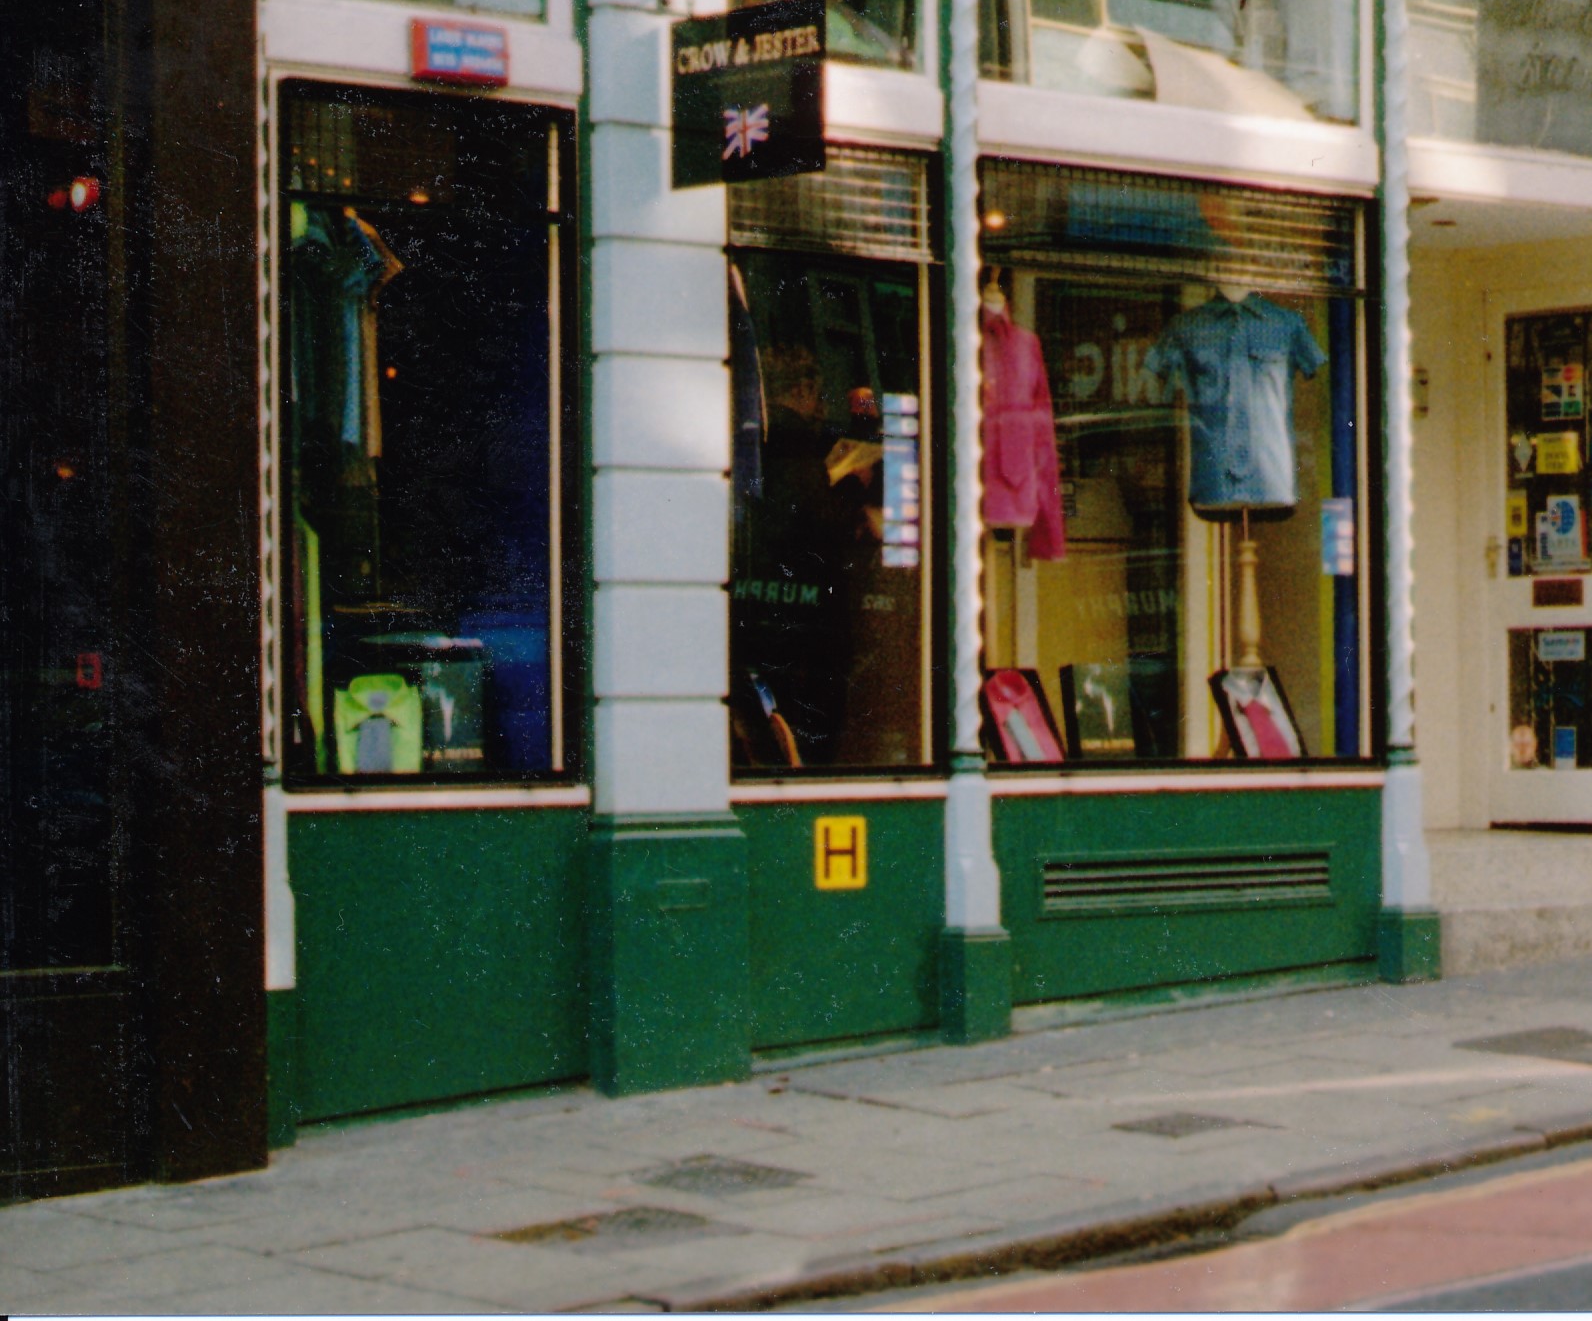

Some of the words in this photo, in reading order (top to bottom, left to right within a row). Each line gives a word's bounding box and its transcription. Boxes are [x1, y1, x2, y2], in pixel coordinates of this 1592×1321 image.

[677, 39, 732, 75] CROW
[733, 37, 750, 66] &
[753, 25, 821, 63] JESTER
[824, 826, 857, 879] H
